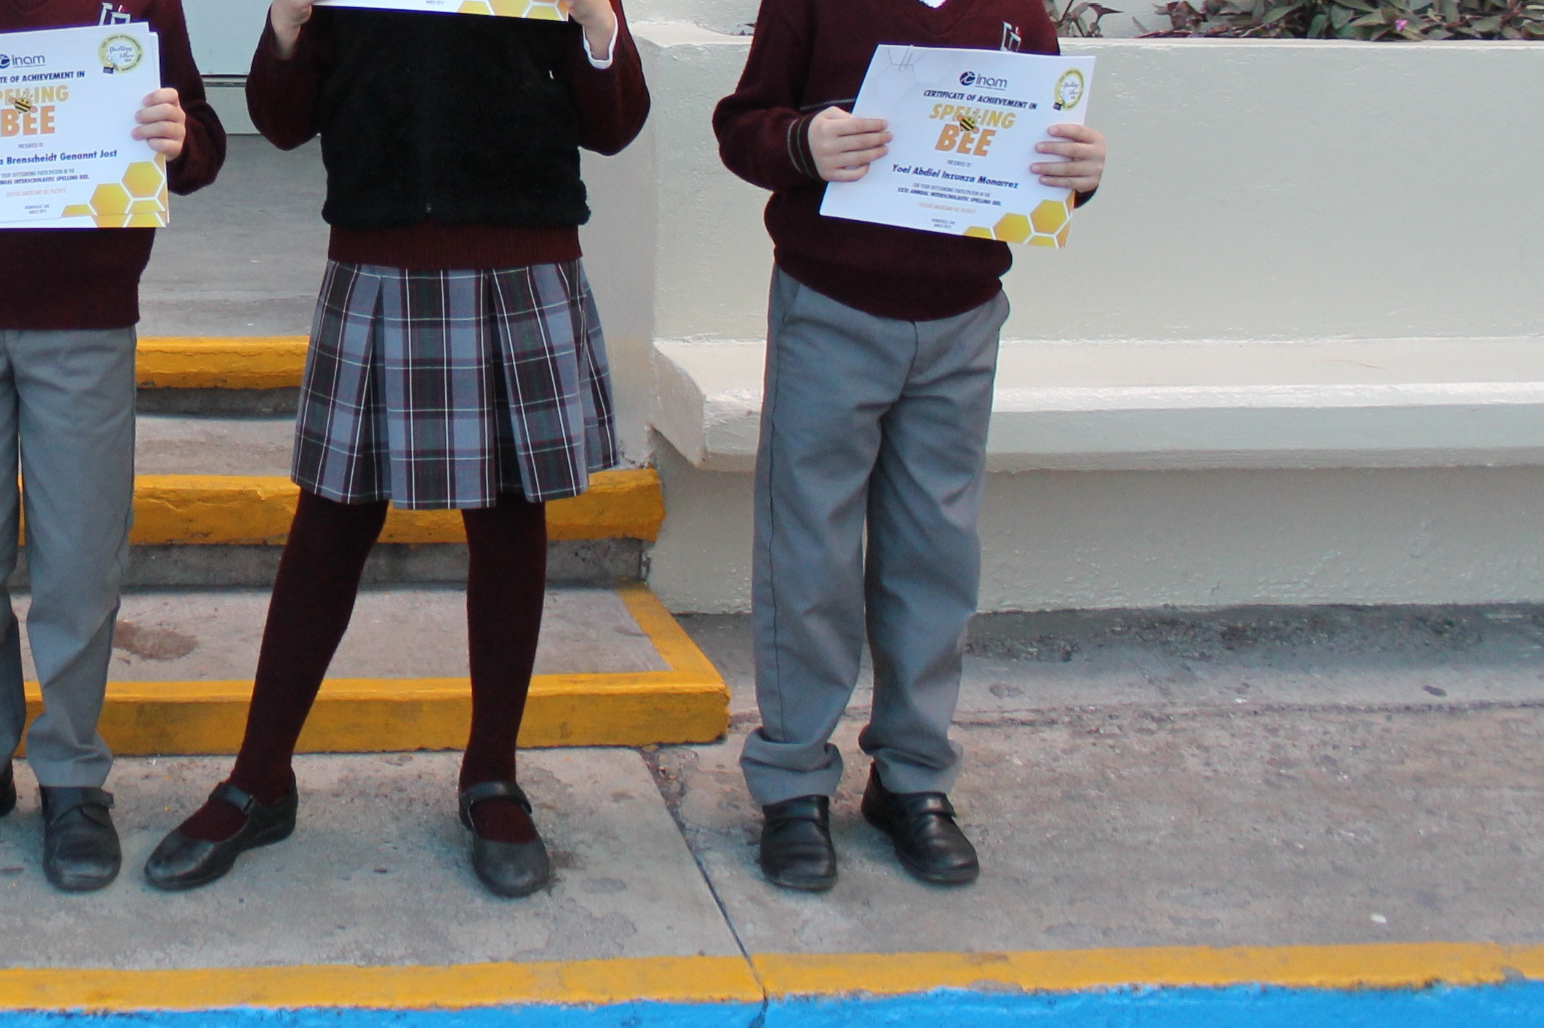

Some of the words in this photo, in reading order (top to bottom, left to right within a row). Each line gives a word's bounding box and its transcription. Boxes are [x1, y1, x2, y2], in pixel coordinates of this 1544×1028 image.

[12, 55, 45, 65] inam
[22, 72, 74, 81] ACHIEVEMENT
[976, 74, 1007, 88] inam
[924, 90, 964, 100] CERTIFICATE
[977, 96, 1028, 108] ACHIEVEMENT
[0, 106, 55, 137] BEE
[935, 124, 996, 156] BEE
[7, 154, 57, 165] Brenscheidt
[60, 151, 96, 160] Genannt
[100, 150, 117, 158] Jost
[892, 164, 910, 174] Yoel
[912, 168, 941, 177] Abdiel
